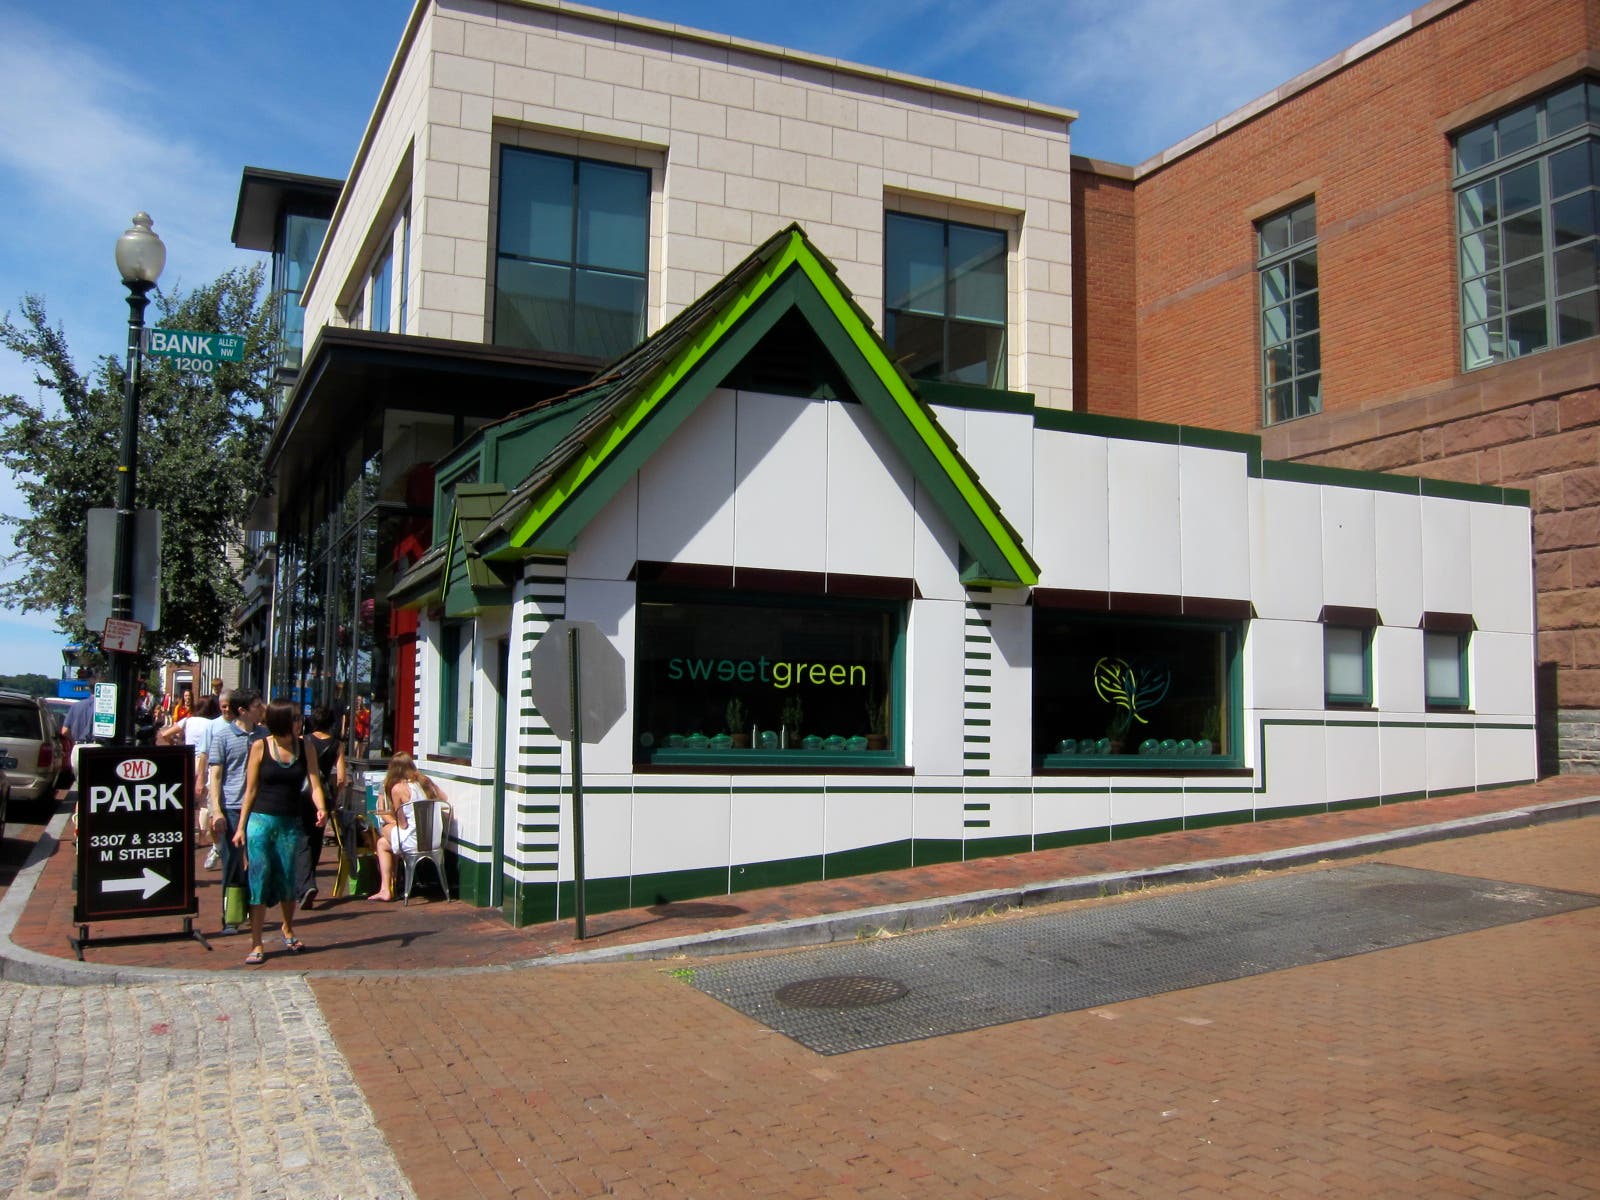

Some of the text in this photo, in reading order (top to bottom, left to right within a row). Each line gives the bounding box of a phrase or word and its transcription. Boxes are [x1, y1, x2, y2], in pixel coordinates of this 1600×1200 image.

[152, 332, 213, 356] BANK
[218, 338, 238, 347] ALLEY
[220, 348, 234, 357] NW
[174, 357, 213, 372] 1200
[667, 655, 867, 689] sweetgreen
[122, 761, 152, 779] PMI
[90, 783, 184, 813] PARK
[90, 831, 183, 847] 3307 & 3333
[100, 847, 173, 862] M STREET
